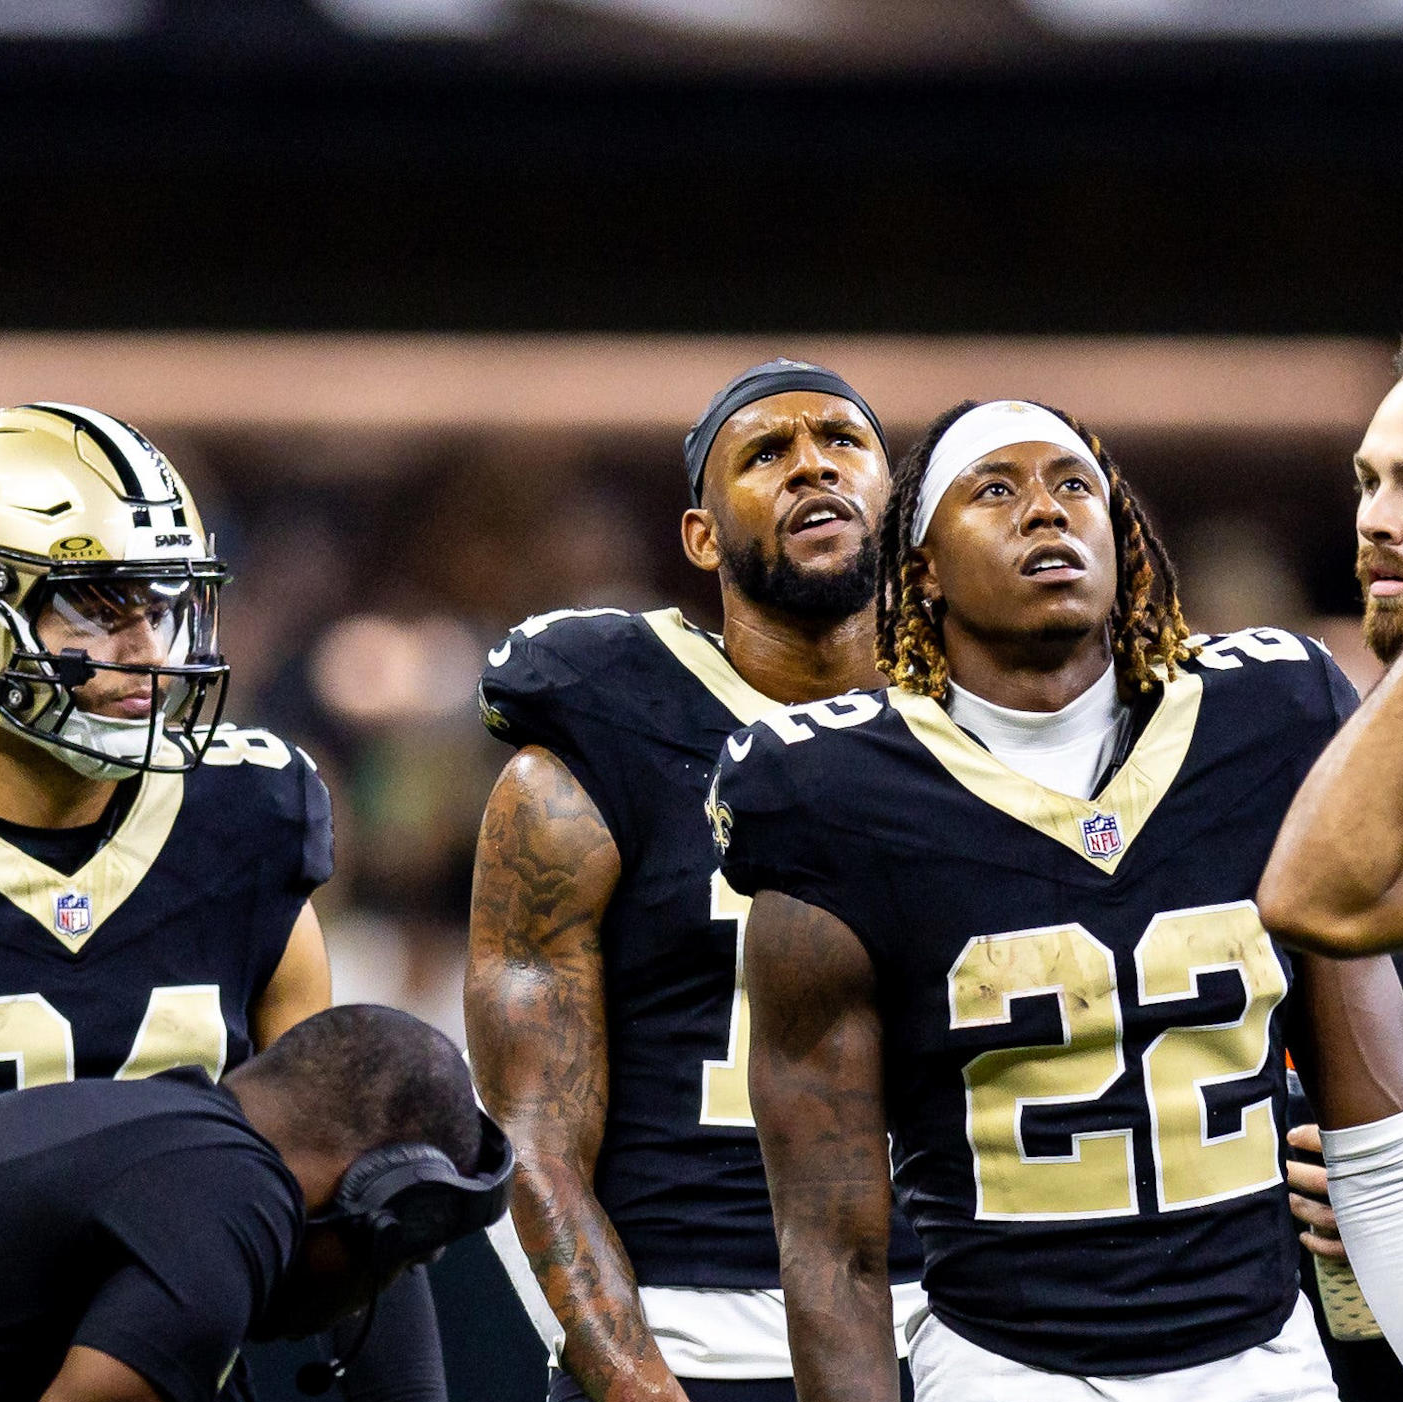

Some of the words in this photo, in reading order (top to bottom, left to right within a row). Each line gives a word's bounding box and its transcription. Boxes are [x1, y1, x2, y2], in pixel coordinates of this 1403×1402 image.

[155, 533, 193, 548] SAINTS
[52, 549, 103, 560] OAKLEY
[947, 899, 1288, 1222] 22
